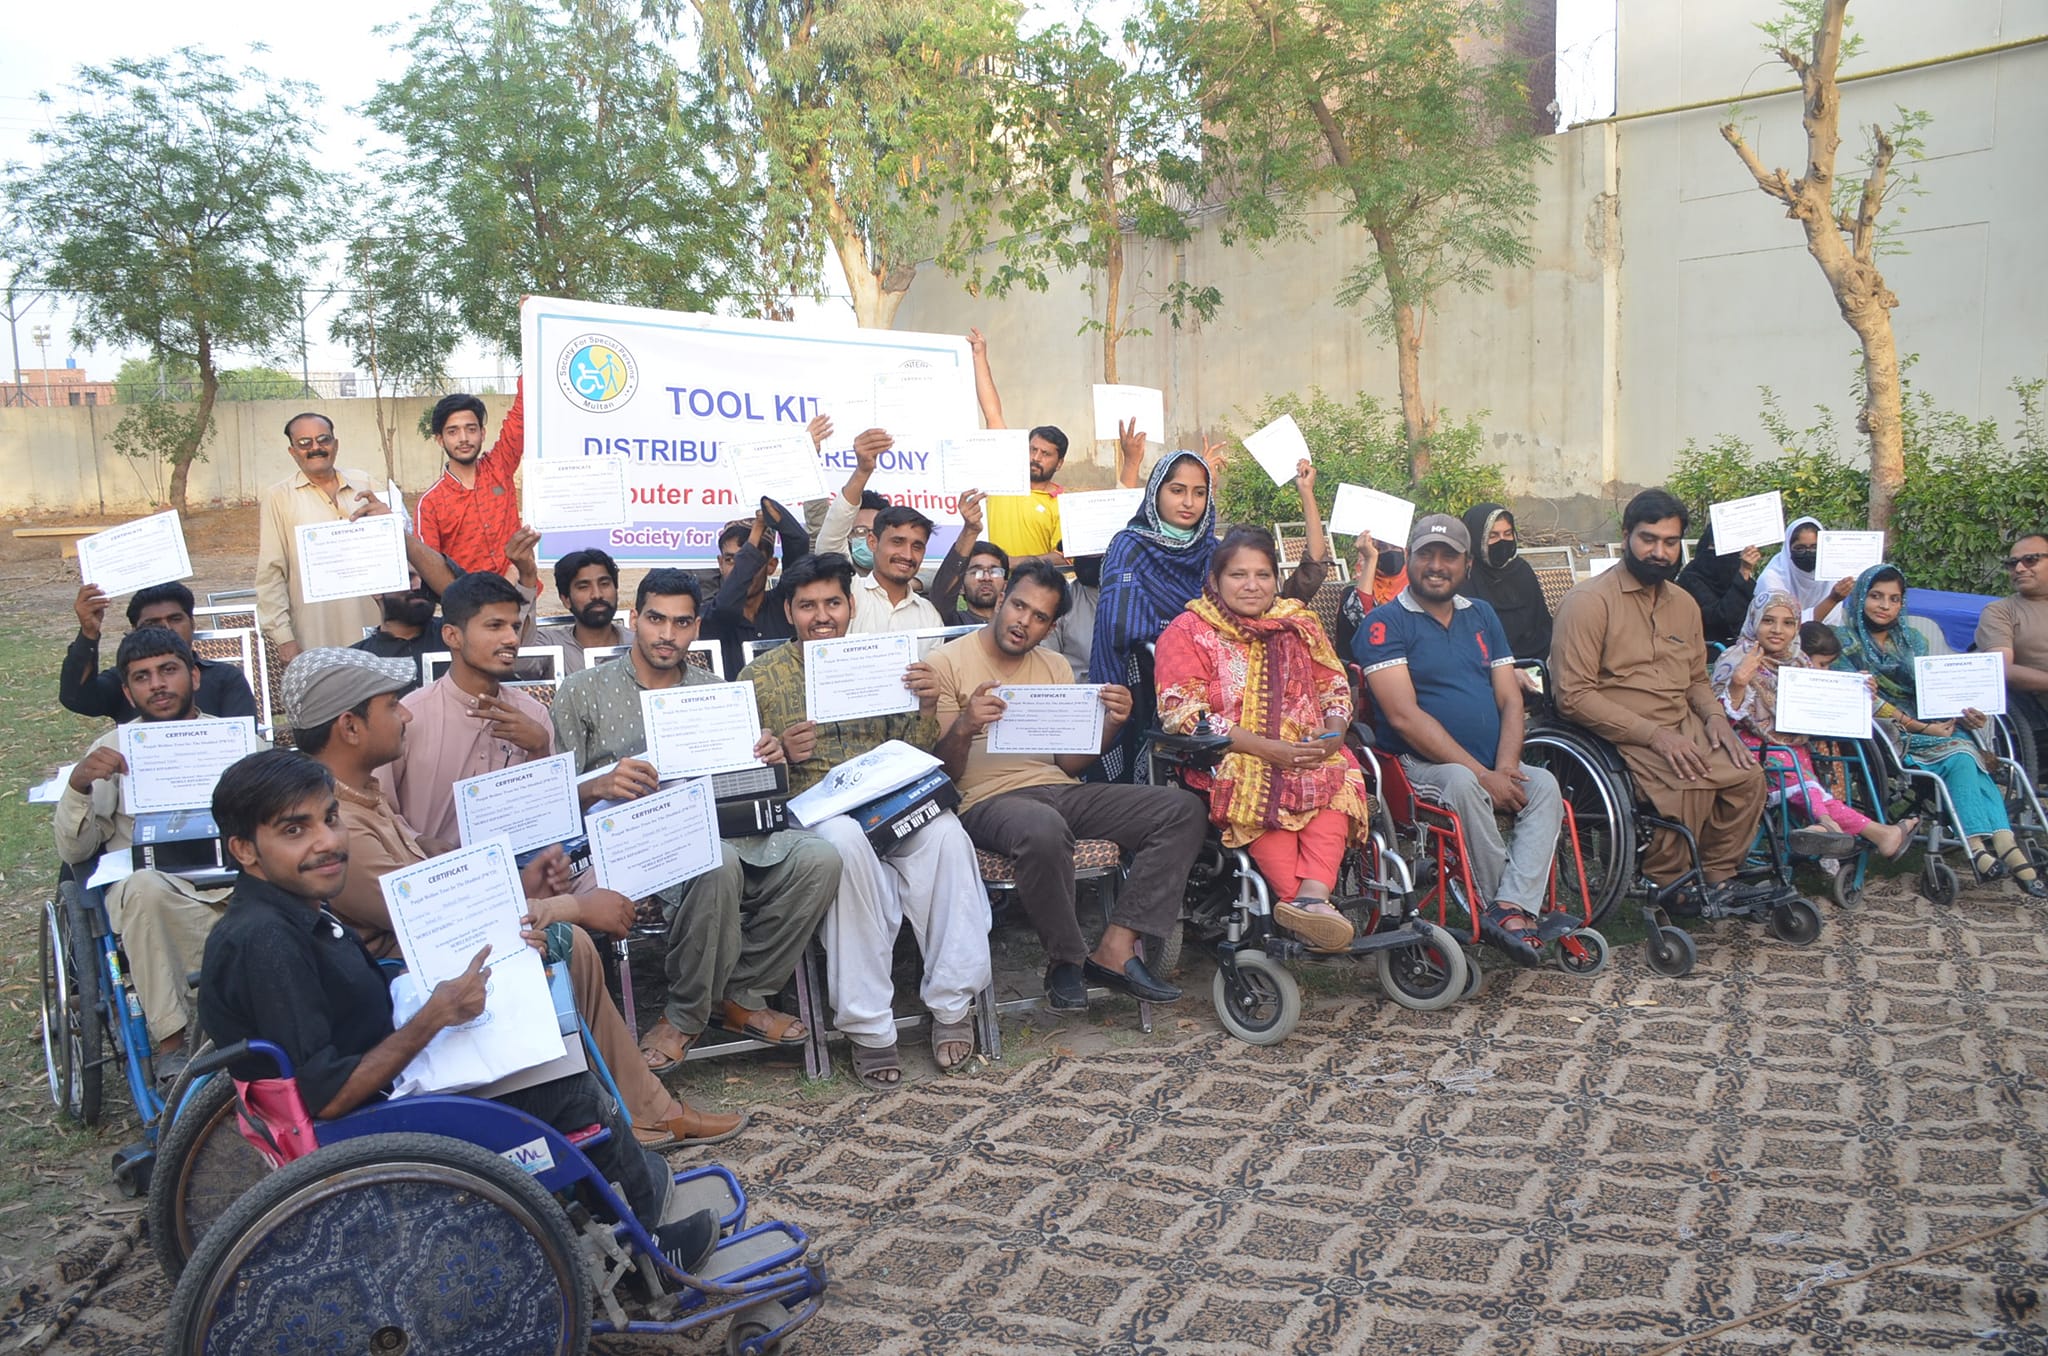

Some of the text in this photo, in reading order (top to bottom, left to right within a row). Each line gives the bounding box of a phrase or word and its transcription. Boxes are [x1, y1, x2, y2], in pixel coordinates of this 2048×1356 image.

[559, 336, 635, 380] Society For Special Persons
[583, 400, 614, 410] Multan
[665, 386, 821, 423] TOOL KIT
[584, 437, 717, 463] DISTRIBU
[702, 488, 739, 505] an
[611, 528, 680, 548] Society
[686, 529, 712, 544] for
[1369, 621, 1387, 646] 3
[842, 644, 878, 653] CERTIFICATE
[680, 694, 716, 704] CERTIFICATE
[495, 772, 533, 787] CERTIFICATE
[631, 801, 671, 820] CERTIFICATE
[925, 802, 941, 820] HOT
[910, 812, 925, 828] AIR
[894, 821, 912, 839] GUN
[427, 863, 469, 884] CERTIFICATE
